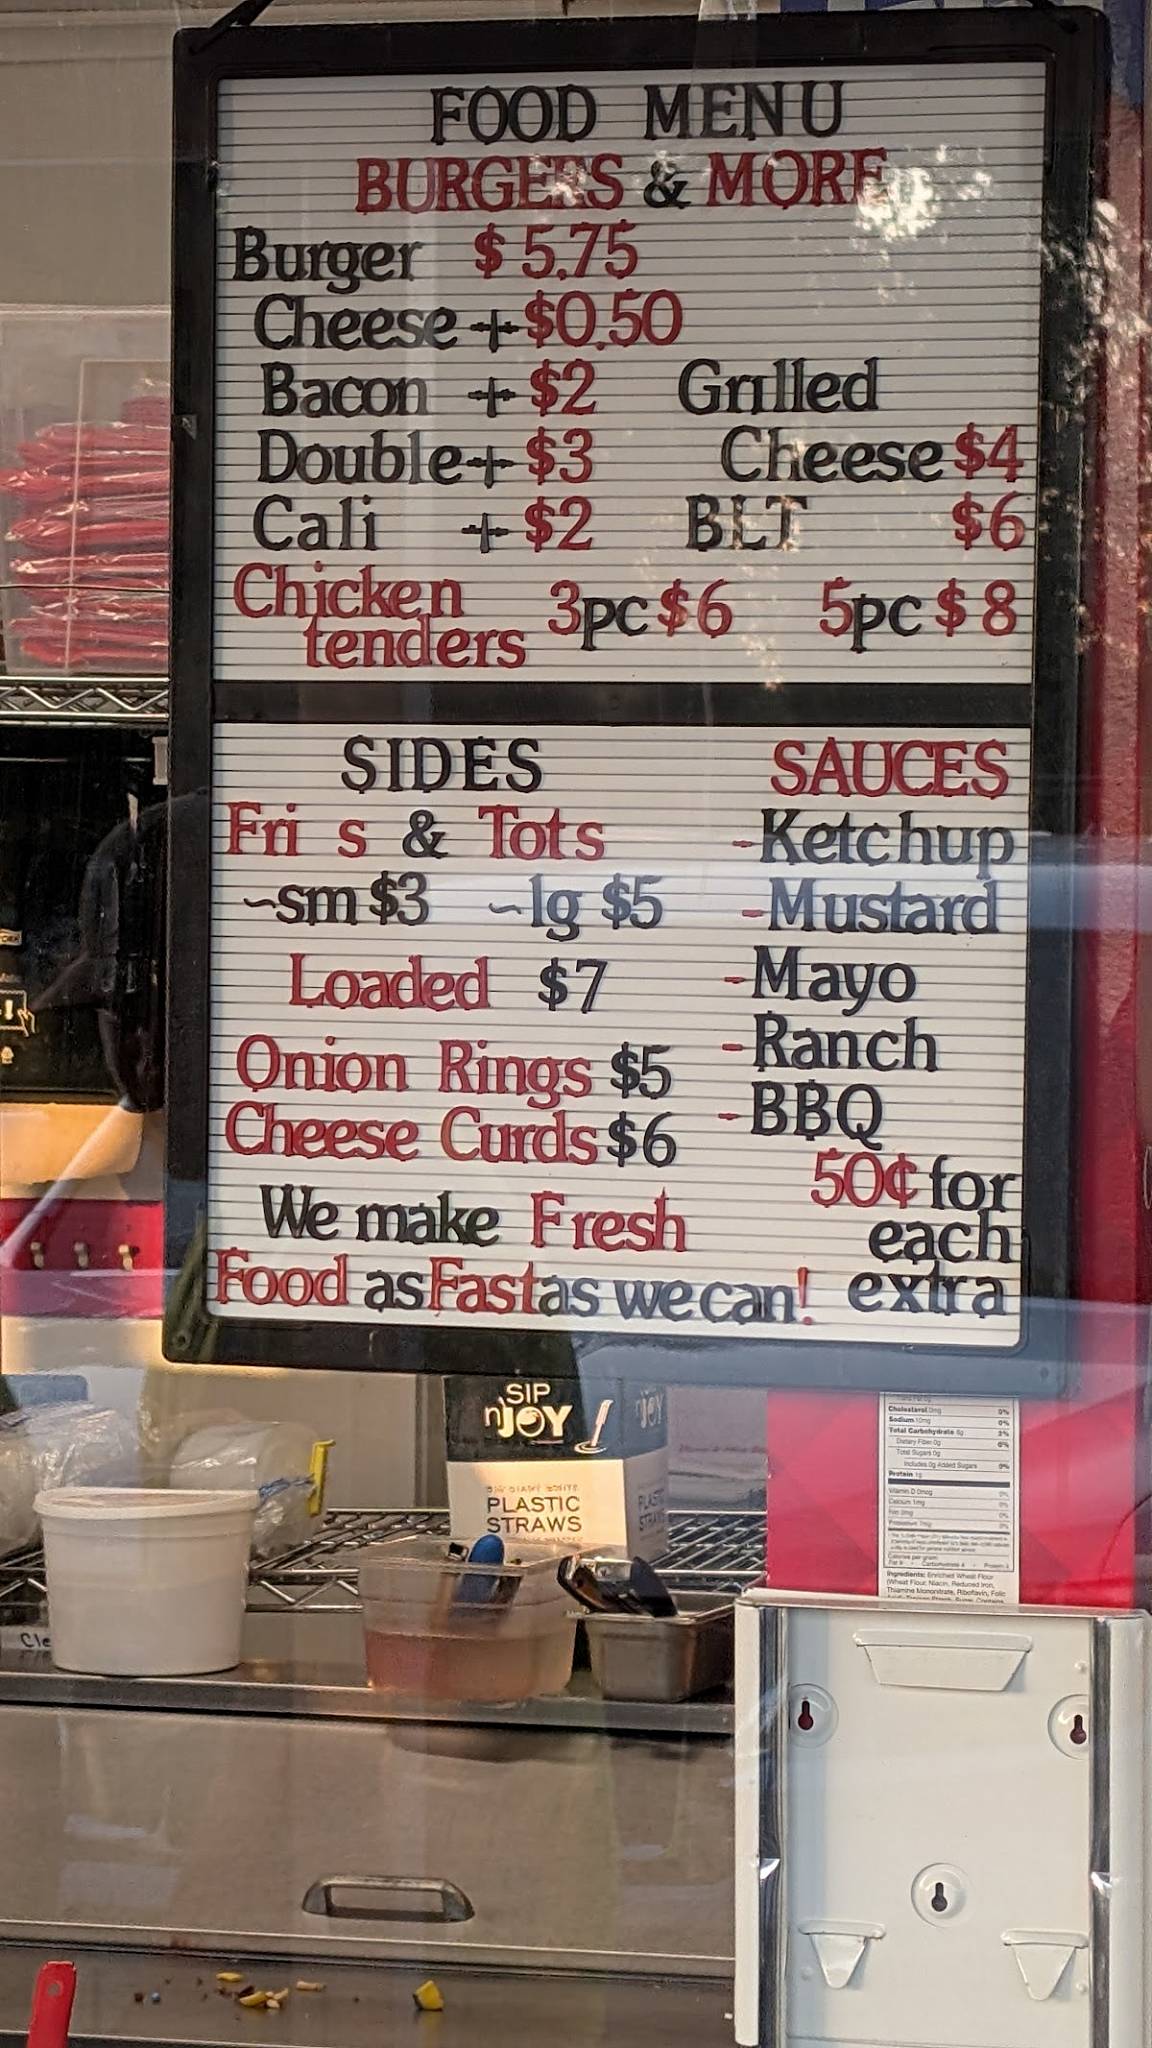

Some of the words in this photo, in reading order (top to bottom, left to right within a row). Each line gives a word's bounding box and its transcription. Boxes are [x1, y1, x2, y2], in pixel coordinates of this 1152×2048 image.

[430, 84, 597, 146] FOOD
[644, 80, 844, 140] MENU
[355, 153, 624, 215] BURGERS
[642, 158, 692, 209] &
[232, 225, 423, 294] Burger
[254, 292, 458, 352] Cheese
[524, 288, 683, 352] $0.50
[260, 361, 427, 418] Bacon
[529, 357, 597, 417] $2
[678, 356, 880, 415] Grilled
[257, 428, 463, 485] Double
[525, 426, 593, 486] $3
[721, 424, 944, 483] Cheese
[953, 422, 1024, 483] $4
[252, 494, 380, 552] Cali
[524, 495, 593, 552] $2
[685, 493, 808, 551] BLT
[951, 490, 1026, 551] $6
[233, 560, 465, 619] Chicken
[548, 579, 649, 651] 3pc
[657, 578, 734, 639] $6
[819, 576, 922, 654] 5pc
[302, 613, 527, 669] tenders
[341, 734, 543, 794] SIDES
[770, 737, 1009, 799] SAUCES
[402, 809, 449, 859] &
[478, 804, 605, 861] Tots
[369, 870, 430, 926] $3
[601, 873, 663, 930] $5
[288, 952, 492, 1011] Loaded
[538, 957, 609, 1014] $7
[236, 1033, 409, 1094] Onion
[439, 1038, 592, 1110] Rings
[610, 1041, 672, 1099] $5
[224, 1100, 419, 1161] Cheese
[440, 1106, 598, 1165] Curds
[606, 1111, 677, 1168] $6
[810, 1147, 918, 1209] 50¢
[929, 1154, 1022, 1212] for
[259, 1184, 340, 1240] We
[355, 1190, 500, 1247] make
[530, 1187, 688, 1253] Fresh
[868, 1207, 1014, 1265] each
[215, 1246, 350, 1308] Food
[364, 1268, 424, 1313] as
[427, 1255, 540, 1316] Fast
[539, 1274, 600, 1316] as
[613, 1275, 693, 1323] we
[700, 1266, 813, 1325] can!
[847, 1260, 1006, 1319] extra
[506, 1383, 550, 1405] SIP
[908, 1428, 954, 1436] Carbohydrate
[487, 1496, 580, 1513] PLASTIC
[487, 1516, 582, 1533] STRAWS
